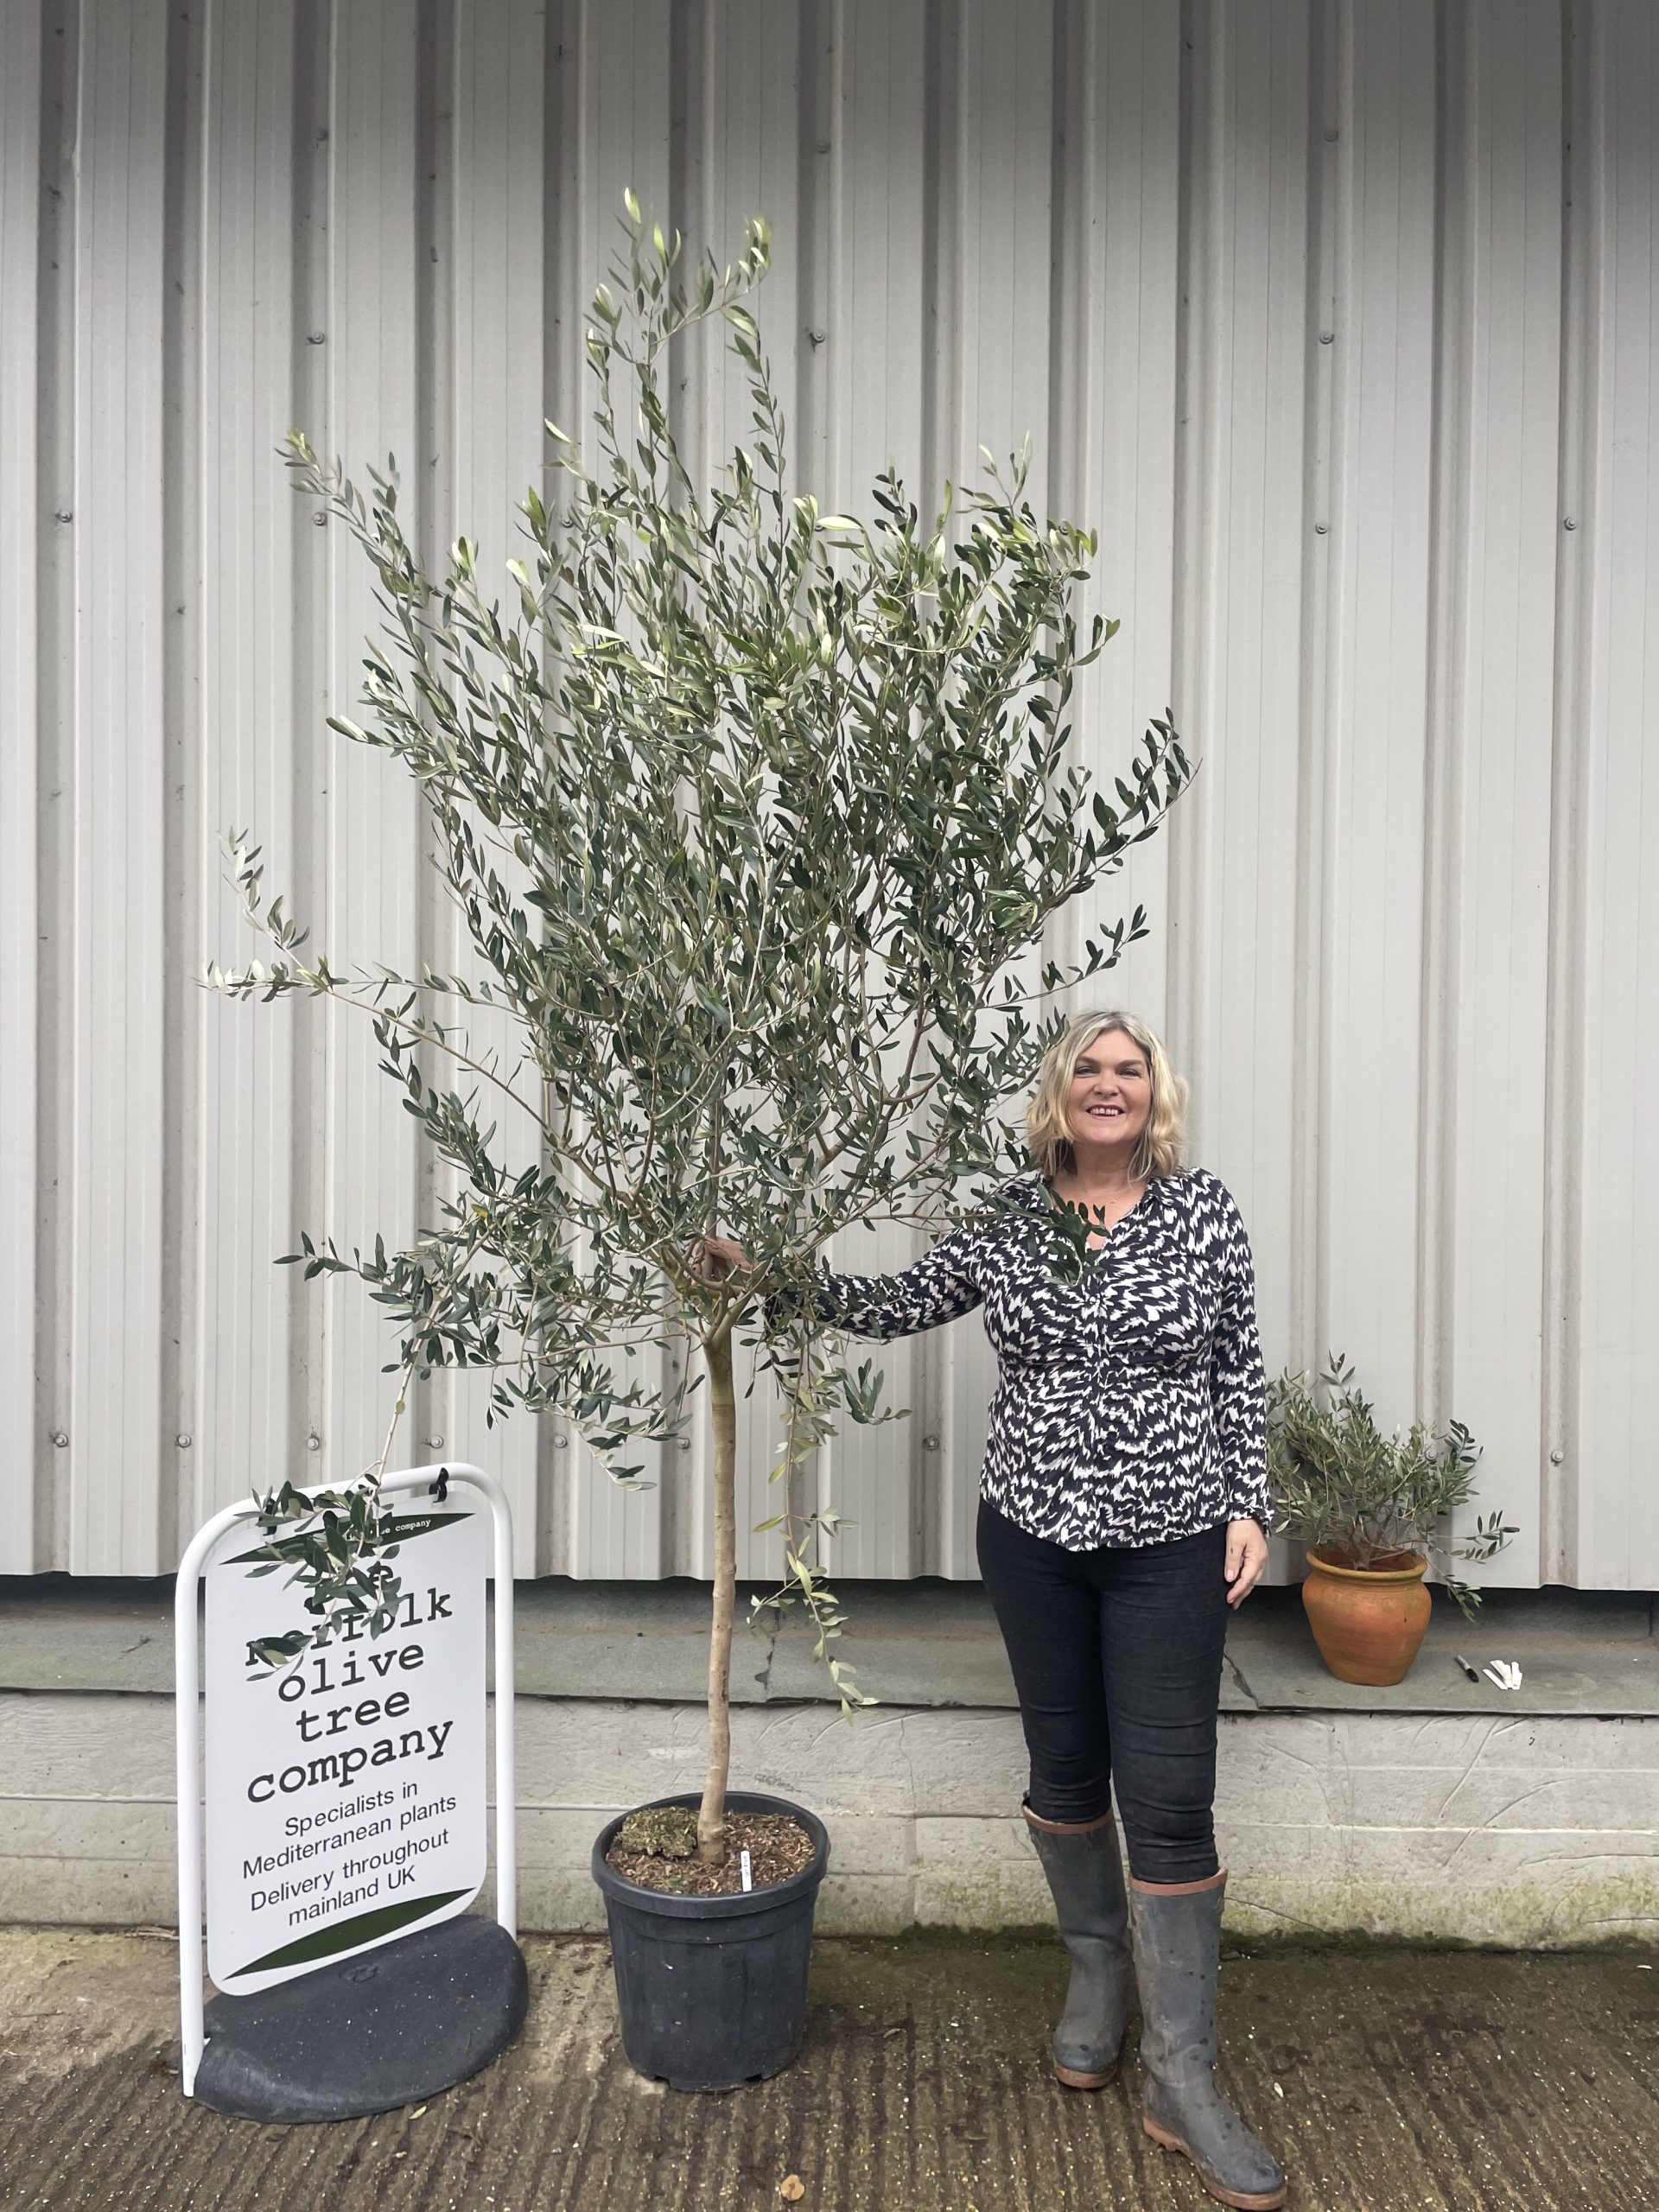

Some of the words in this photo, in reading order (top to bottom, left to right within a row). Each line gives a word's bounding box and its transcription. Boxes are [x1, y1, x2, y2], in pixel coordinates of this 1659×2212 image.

[395, 1519, 431, 1532] company
[279, 1645, 423, 1701] olive
[296, 1692, 409, 1742] tree
[248, 1721, 453, 1802] company
[244, 1819, 391, 1878] Mediterranean
[401, 1797, 455, 1830] plants
[285, 1791, 393, 1836] Specialists
[404, 1783, 416, 1798] in
[251, 1871, 334, 1910] Delivery
[343, 1829, 448, 1878] throughout
[289, 1883, 378, 1925] mainland
[389, 1866, 415, 1889] UK
